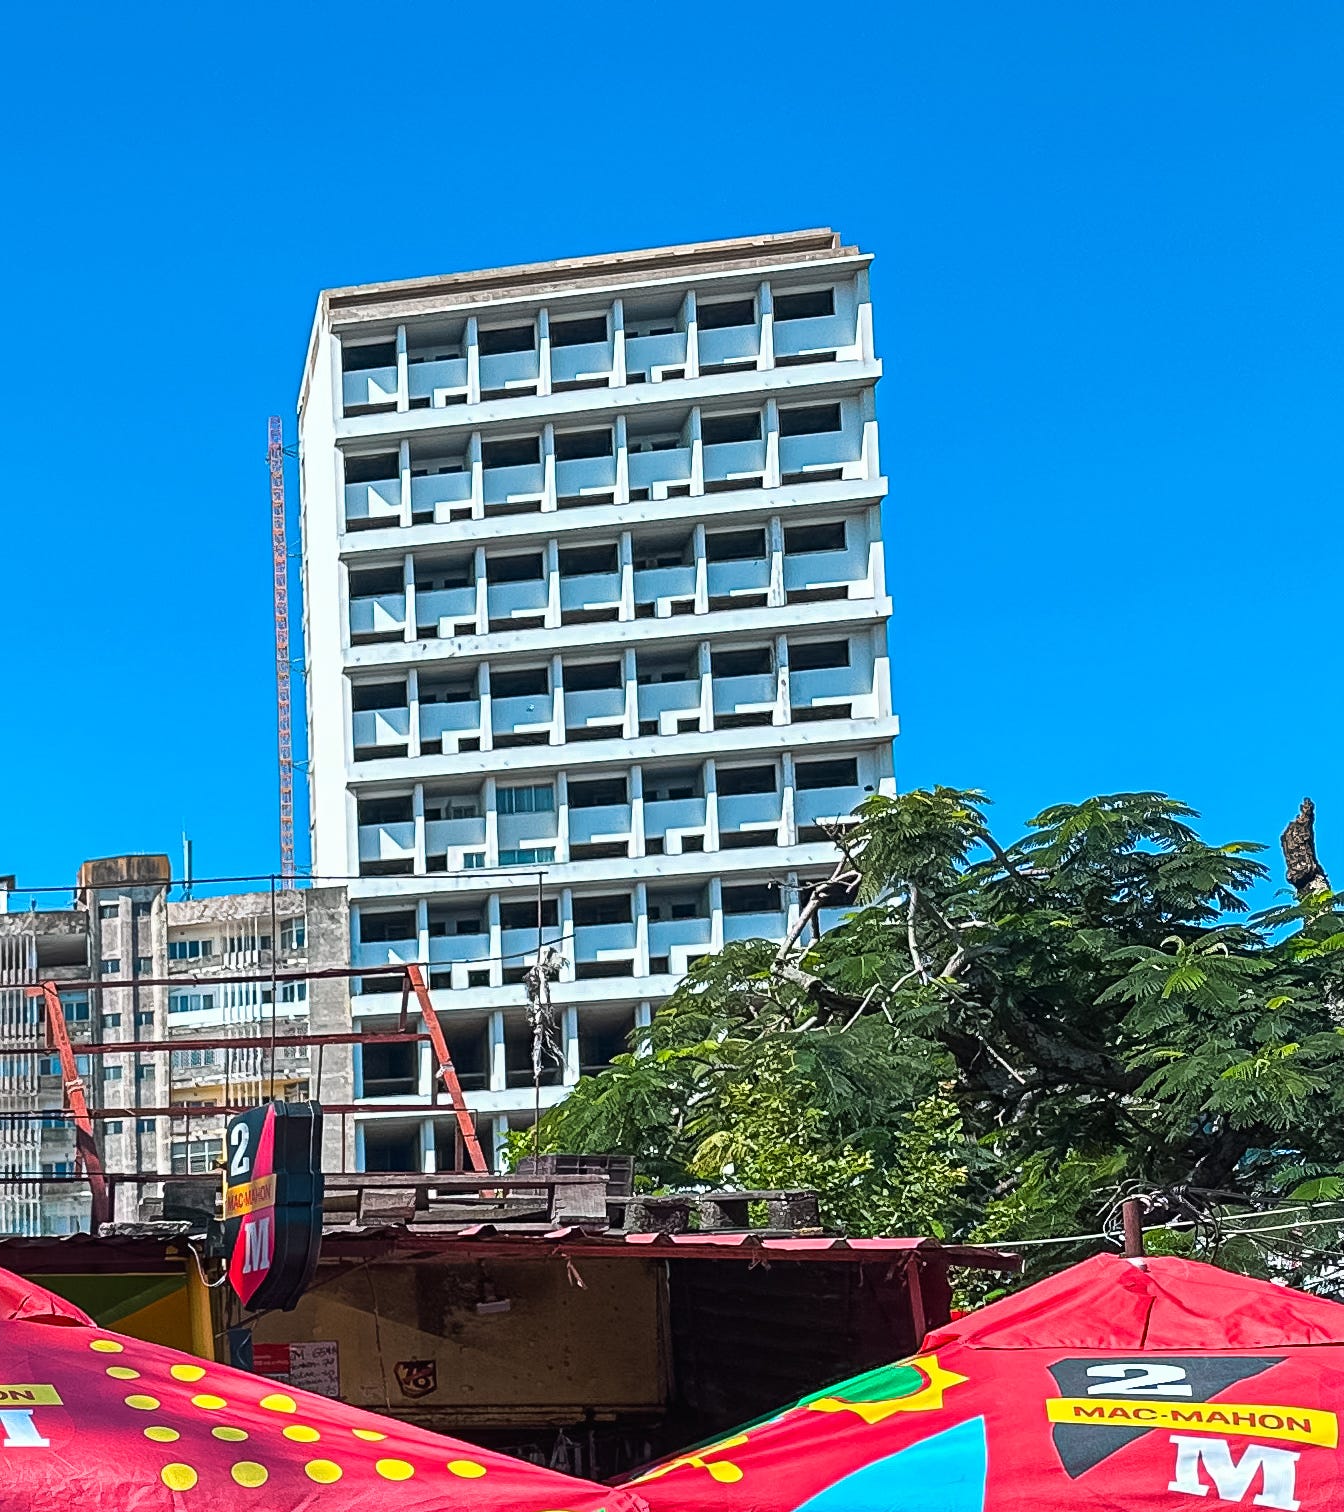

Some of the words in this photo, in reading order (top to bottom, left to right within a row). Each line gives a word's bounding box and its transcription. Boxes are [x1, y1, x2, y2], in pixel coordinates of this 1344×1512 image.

[230, 1122, 250, 1177] 2
[242, 1217, 271, 1274] M
[1086, 1363, 1192, 1397] 2
[1072, 1404, 1312, 1433] MAC-MAHON
[1168, 1434, 1301, 1512] M
